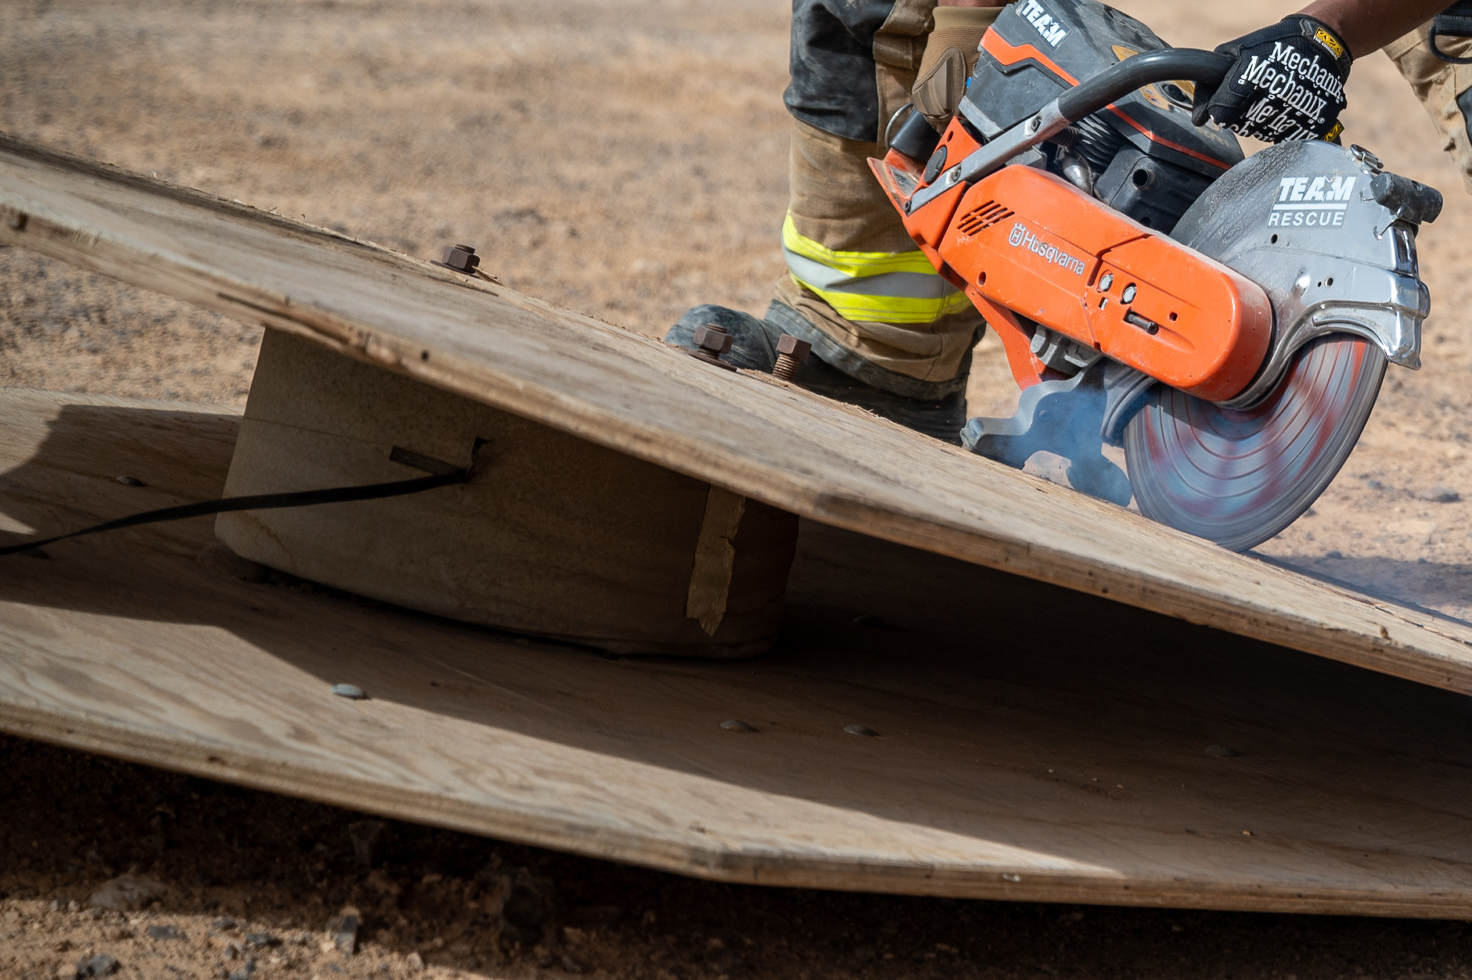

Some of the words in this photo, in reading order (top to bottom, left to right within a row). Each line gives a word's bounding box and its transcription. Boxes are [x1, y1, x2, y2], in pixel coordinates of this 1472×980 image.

[1278, 175, 1357, 202] TEAM
[1267, 211, 1345, 227] RESCUE
[1021, 230, 1086, 276] Husqvarna
